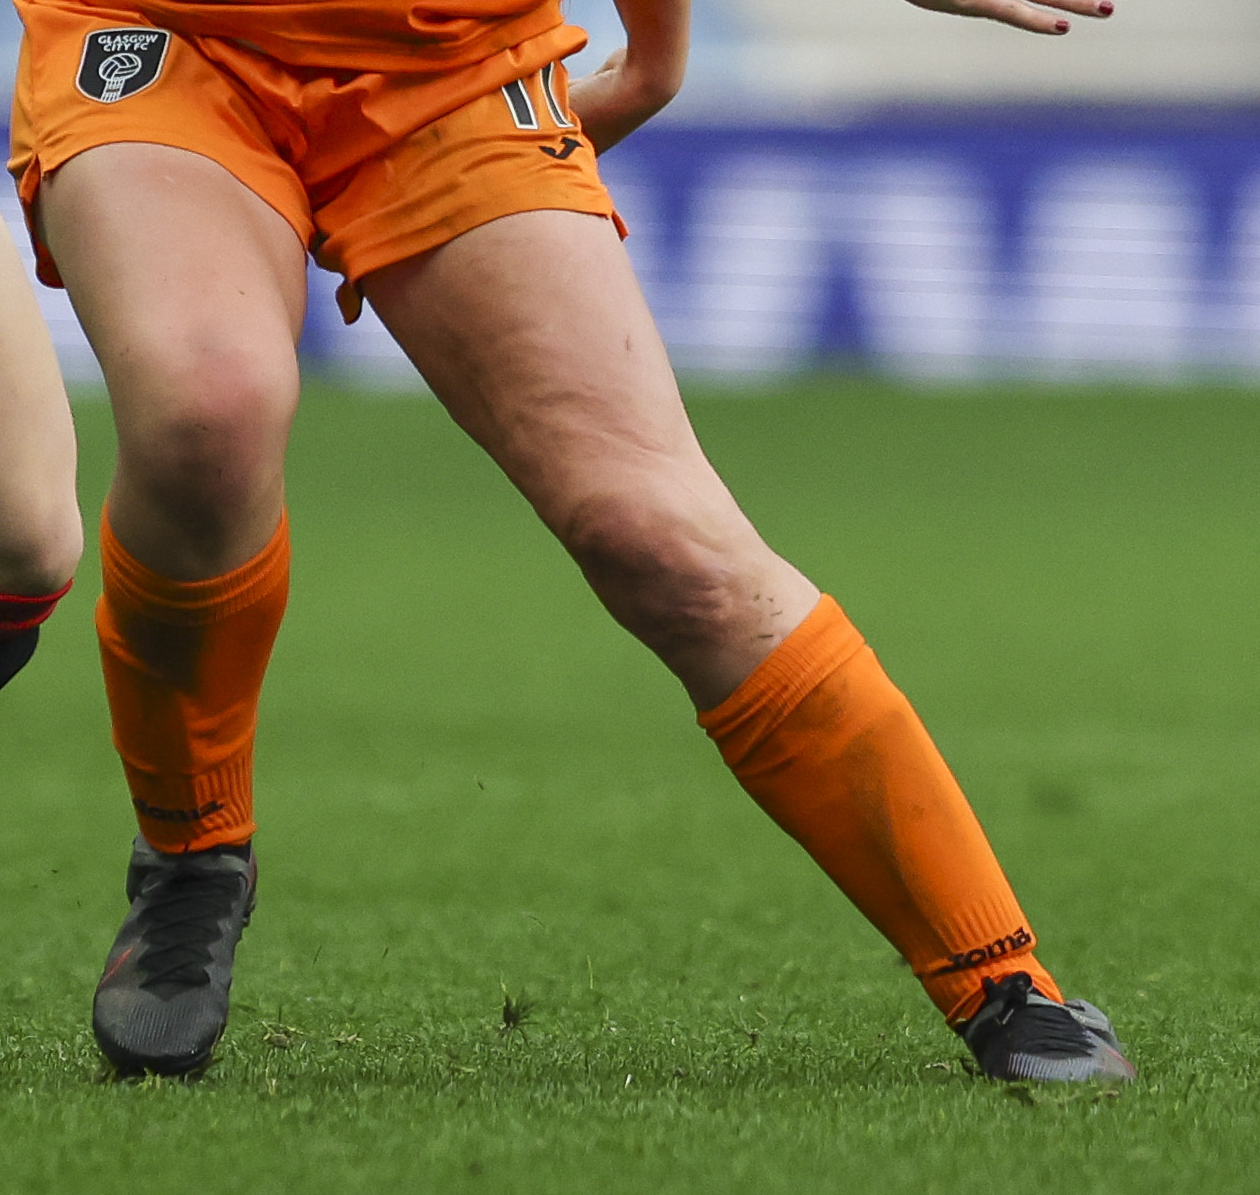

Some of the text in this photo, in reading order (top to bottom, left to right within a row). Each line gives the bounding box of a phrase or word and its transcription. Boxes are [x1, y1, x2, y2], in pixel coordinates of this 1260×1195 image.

[98, 34, 159, 44] GLASGOW
[103, 42, 149, 52] CITY FC
